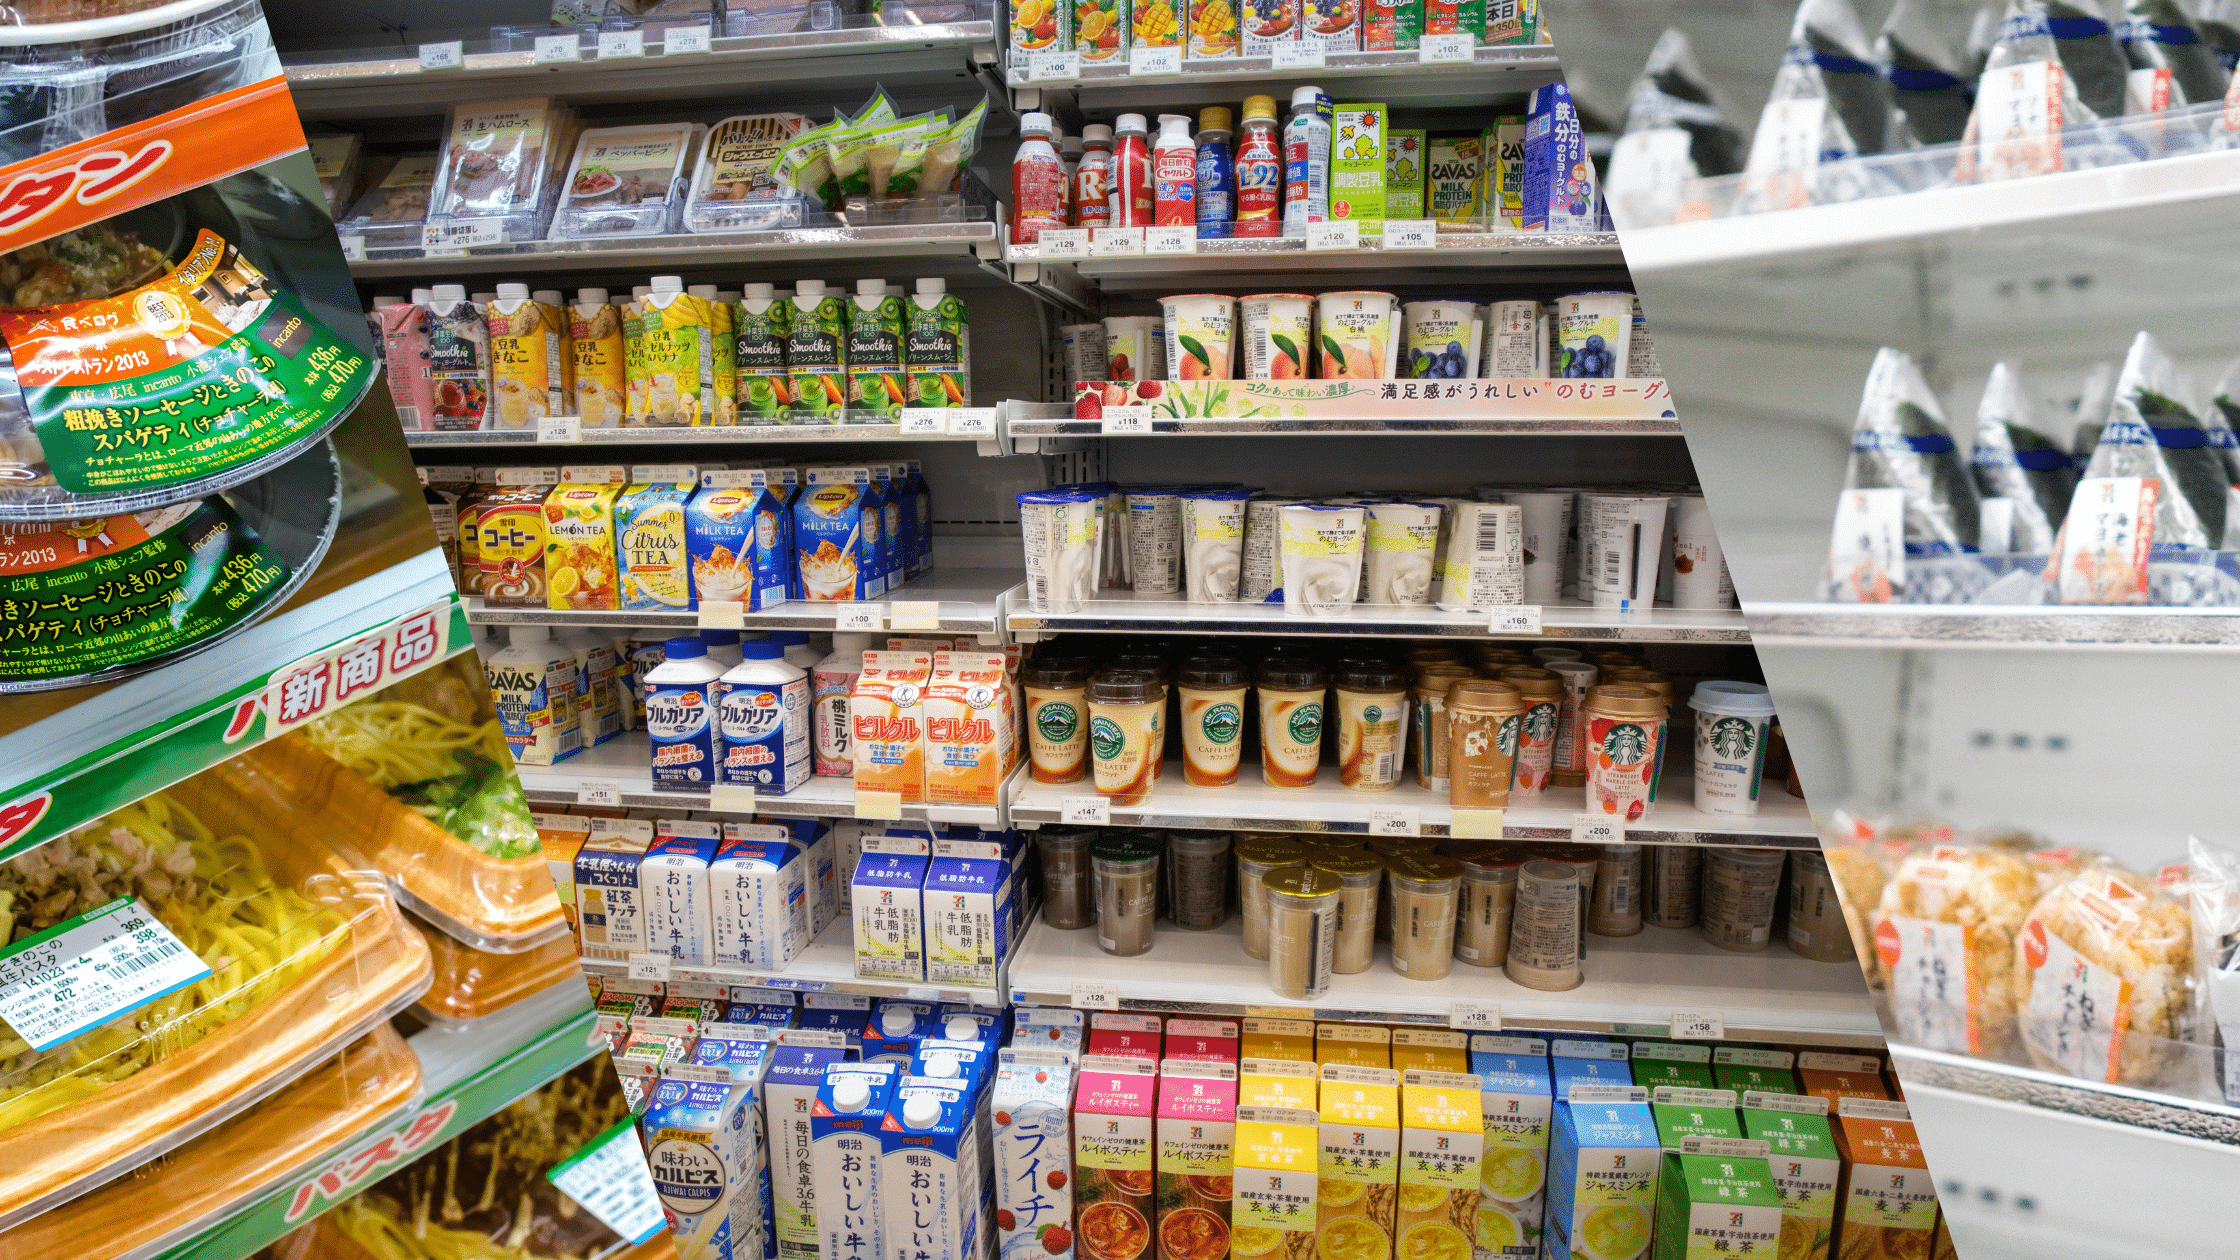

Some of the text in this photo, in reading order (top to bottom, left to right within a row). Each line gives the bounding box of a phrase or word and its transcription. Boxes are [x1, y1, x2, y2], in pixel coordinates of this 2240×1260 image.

[1554, 102, 1571, 205] 鉄分のむヨーグルト
[1162, 169, 1190, 178] ヤクルト
[1431, 163, 1476, 181] SAVAS
[1333, 171, 1383, 189] 調製豆乳
[1441, 182, 1466, 192] MILK
[1433, 191, 1473, 201] PROTEIN
[1323, 233, 1345, 241] ¥120
[1401, 233, 1423, 241] ¥105
[147, 300, 166, 314] BEST
[60, 312, 119, 331] 食べログ
[155, 310, 175, 324] 2013
[1337, 319, 1378, 328] のむヨーグルト
[268, 316, 302, 349] incanto
[652, 330, 671, 342] 豆乳
[431, 343, 469, 359] Smoothie
[497, 338, 520, 351] 豆乳
[576, 341, 598, 352] 豆乳
[738, 341, 782, 356] Smoothie
[789, 338, 832, 354] Smoothie
[850, 338, 893, 353] Smoothie
[909, 338, 952, 353] Smoothie
[303, 345, 341, 387] 本体436円
[142, 374, 182, 394] incanto
[320, 356, 363, 403] (税込470円)
[63, 355, 276, 431] 粗挽きソーセージときのこの
[1245, 382, 1350, 398] コクがあって味わい濃厚
[1380, 383, 1539, 400] 満足感がうれしい
[915, 418, 934, 426] ¥276
[962, 419, 982, 427] ¥276
[1118, 418, 1139, 426] ¥118
[568, 491, 597, 500] Lipton
[709, 496, 740, 504] Lipton
[815, 493, 846, 501] Lipton
[499, 518, 517, 527] 雪印
[550, 523, 606, 535] LEMON TEA
[631, 517, 668, 531] Summer
[830, 521, 850, 531] TEA
[725, 526, 744, 536] TEA
[188, 522, 229, 554] incanto
[483, 528, 536, 548] コーヒー
[621, 530, 681, 551] Citrus
[46, 539, 167, 588] incanto 小池シェフ監修
[632, 549, 670, 566] TEA
[211, 553, 263, 596] 本体436円
[225, 565, 283, 612] (税込470円)
[851, 615, 869, 624] ¥100
[1507, 617, 1528, 625] ¥160
[279, 613, 437, 724] 新商品
[489, 671, 538, 692] SAVAS
[885, 669, 928, 682] ピルクル
[958, 670, 1000, 683] ピルクル
[500, 694, 523, 704] MILK
[663, 697, 678, 705] 明治
[496, 703, 531, 713] PROTEIN
[647, 706, 704, 725] ブルガリア
[721, 706, 778, 725] ブルガリア
[831, 698, 849, 753] 桃ミルク
[853, 714, 921, 742] ピルクル
[926, 716, 995, 745] ピルクル
[657, 745, 695, 758] 腸内細菌の
[729, 745, 767, 758] 腸内細菌の
[652, 752, 703, 766] バランスを整える
[723, 752, 775, 766] バランスを整える
[1077, 808, 1097, 816] ¥147
[1386, 820, 1407, 828] ¥200
[1589, 828, 1610, 836] ¥200
[673, 839, 699, 848] meiji
[741, 843, 766, 851] meiji
[576, 856, 636, 874] 牛乳屋さんが
[666, 858, 685, 866] 明治
[735, 862, 754, 870] 明治
[593, 873, 634, 886] つくった
[866, 869, 913, 879] 低脂肪牛乳
[939, 874, 985, 884] 低脂肪牛乳
[606, 890, 633, 904] 紅茶
[607, 905, 637, 918] ラッテ
[666, 870, 685, 960] おいしい牛乳
[120, 917, 146, 934] 369
[736, 874, 754, 964] おいしい牛乳
[874, 907, 887, 932] 牛乳
[887, 907, 900, 943] 低脂肪
[946, 911, 959, 936] 牛乳
[132, 928, 158, 944] 398
[959, 911, 973, 948] 低脂肪
[22, 966, 66, 989] 14.10.23
[54, 987, 77, 1003] 472
[601, 991, 635, 1002] KAGOME
[1086, 994, 1105, 1002] ¥128
[1467, 1013, 1487, 1021] ¥128
[1690, 1023, 1711, 1031] ¥158
[731, 1049, 760, 1058] カルピス
[882, 1043, 909, 1053] meiji
[1489, 1077, 1536, 1088] ジャスミン茶
[691, 1092, 723, 1103] カルピス
[1088, 1098, 1140, 1108] ルイボスティー
[862, 1108, 885, 1117] 900ml
[1171, 1103, 1224, 1114] ルイボスティー
[833, 1120, 864, 1130] meiji
[932, 1125, 955, 1134] 900ml
[660, 1129, 706, 1142] 国産牛乳使用
[902, 1136, 934, 1147] meiji
[1081, 1135, 1146, 1145] カフェインゼロの健康茶
[1593, 1129, 1641, 1141] ジャスミン茶
[837, 1139, 863, 1150] 明治
[1081, 1143, 1146, 1157] ルイボスティー
[1163, 1140, 1230, 1150] カフェインゼロの健康茶
[1163, 1148, 1230, 1162] ルイボスティー
[1325, 1145, 1391, 1158] 国産玄米・茶葉使用
[1408, 1150, 1475, 1164] 国産玄米・茶葉使用
[1880, 1148, 1910, 1160] 麦茶
[283, 1101, 458, 1223] パスタ
[661, 1152, 709, 1167] 味わい
[906, 1155, 932, 1167] 明治
[1333, 1156, 1381, 1170] 玄米茶
[794, 1120, 815, 1227] 毎日の食卓3.6牛乳
[1417, 1159, 1466, 1175] 玄米茶
[654, 1164, 721, 1184] カルピス
[1013, 1124, 1054, 1228] ライチ
[663, 1186, 711, 1198] AJIWAI CALPIS
[1585, 1179, 1650, 1192] ジャスミン茶
[1718, 1186, 1749, 1198] 緑茶
[1240, 1191, 1310, 1204] 国産玄米・茶葉使用
[1250, 1200, 1299, 1216] 玄米茶
[1874, 1199, 1912, 1214] 麦茶
[1694, 1227, 1775, 1241] 国産茶葉・宇治抹茶使用
[1713, 1238, 1756, 1255] 緑茶
